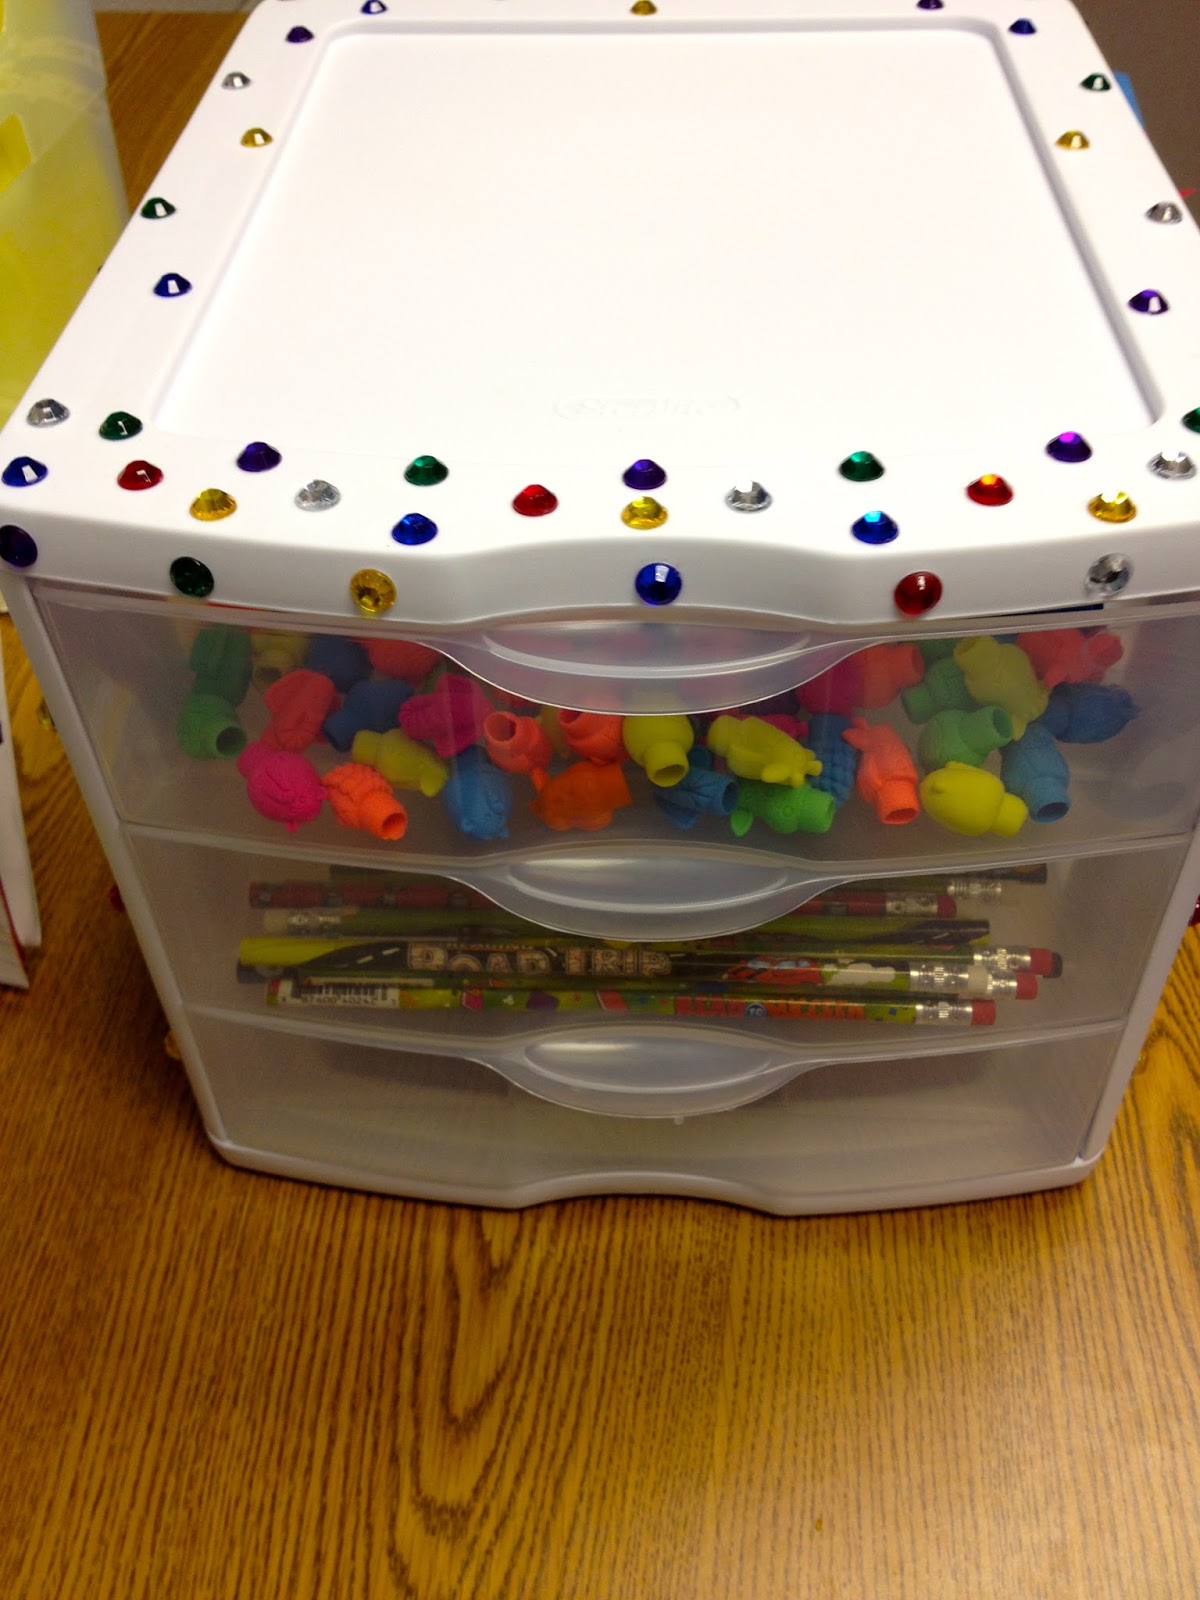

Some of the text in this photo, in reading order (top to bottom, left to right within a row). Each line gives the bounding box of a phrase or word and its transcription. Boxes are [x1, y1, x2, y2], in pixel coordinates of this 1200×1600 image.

[408, 942, 673, 977] ROAD TRIP
[675, 995, 746, 1018] READ
